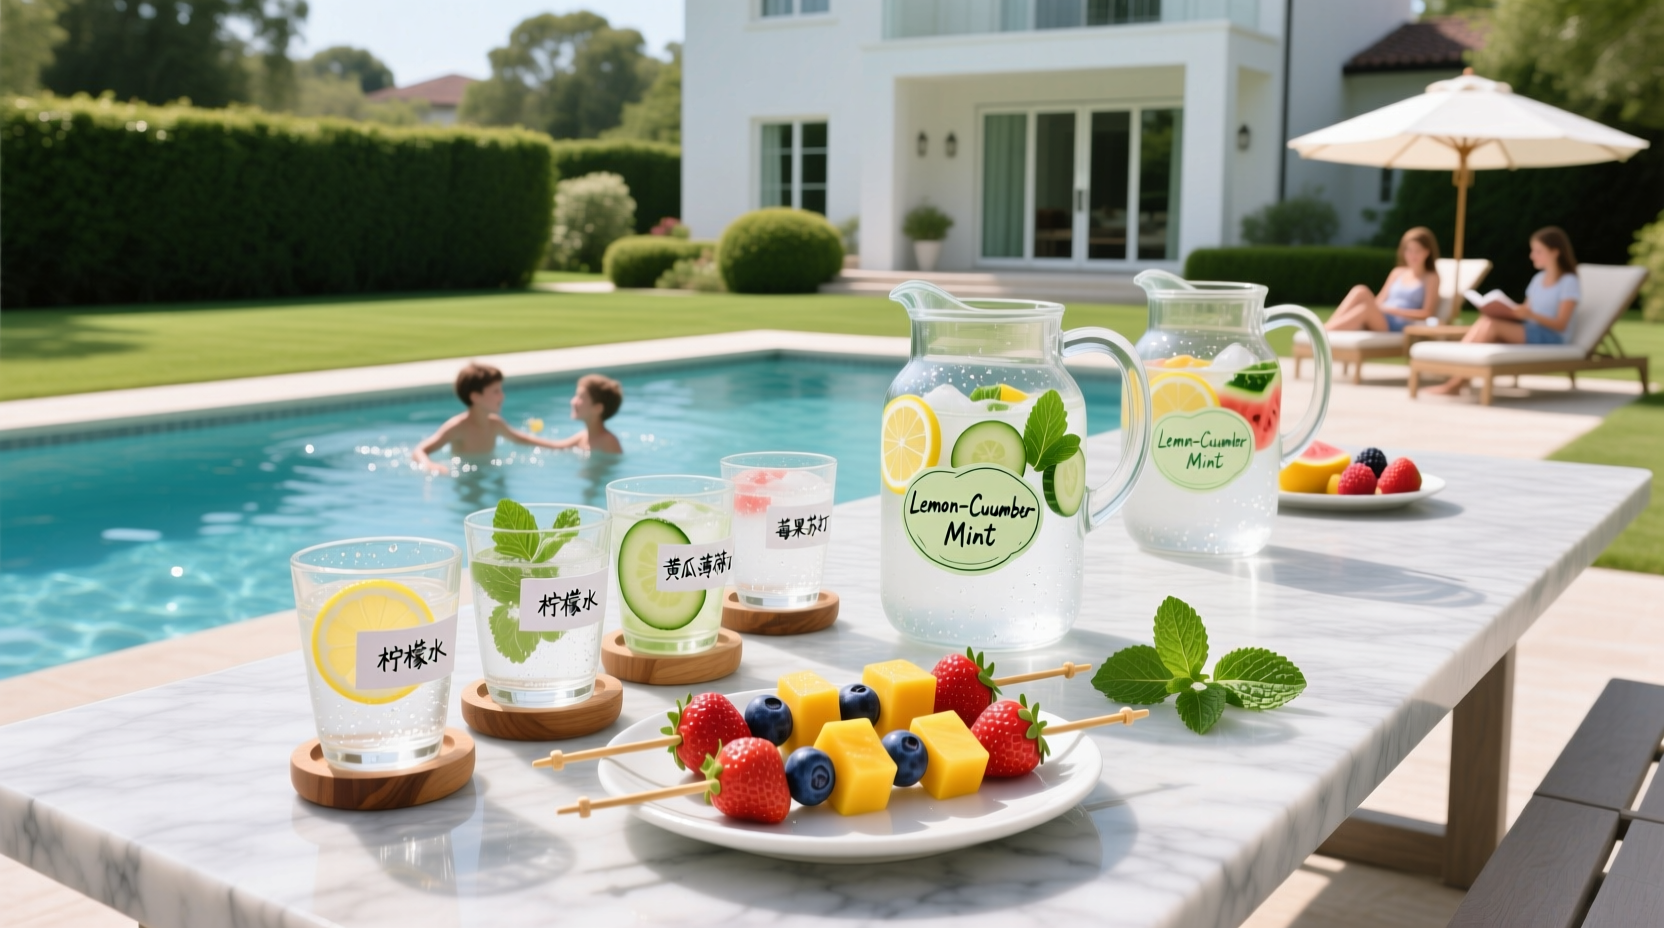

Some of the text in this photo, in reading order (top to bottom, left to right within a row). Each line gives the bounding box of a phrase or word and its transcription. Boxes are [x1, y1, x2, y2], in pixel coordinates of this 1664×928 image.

[1186, 452, 1224, 469] Mint
[944, 521, 997, 547] Mint
[538, 589, 598, 617] 柠檬水
[378, 639, 446, 672] 柠檬水
